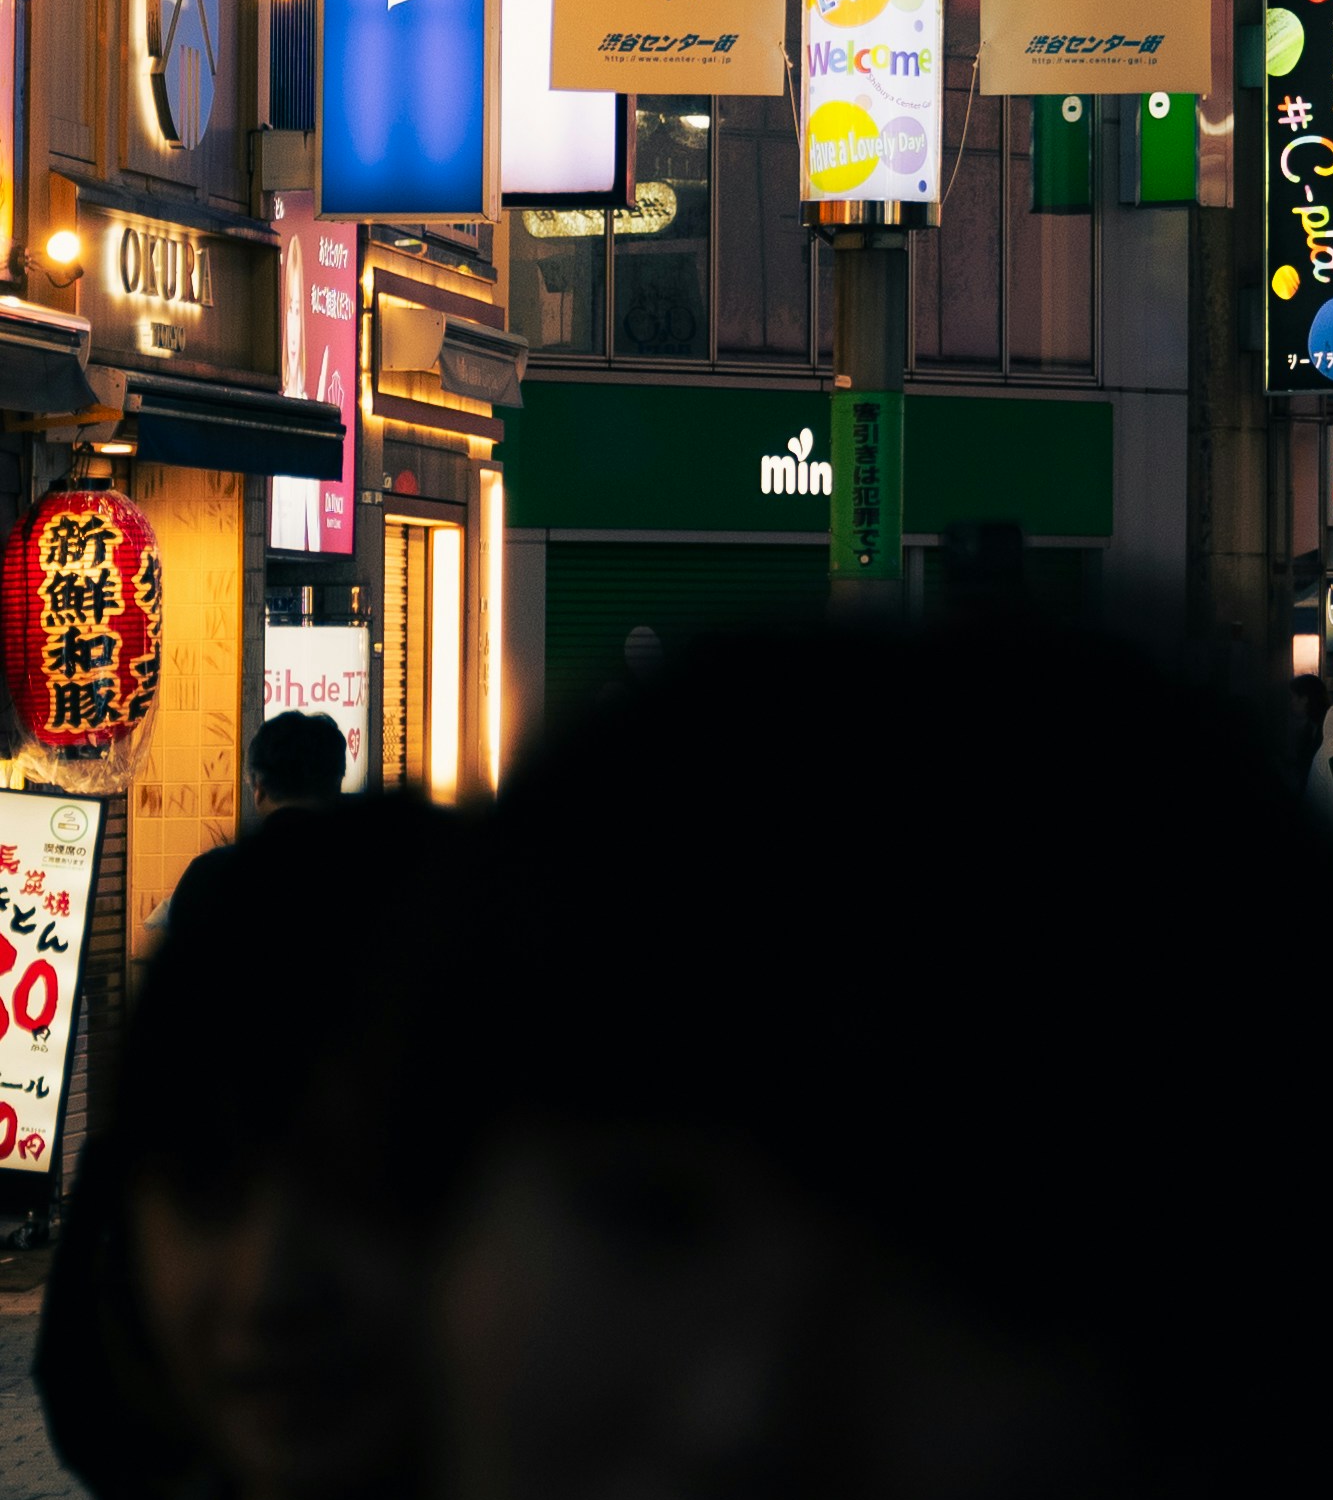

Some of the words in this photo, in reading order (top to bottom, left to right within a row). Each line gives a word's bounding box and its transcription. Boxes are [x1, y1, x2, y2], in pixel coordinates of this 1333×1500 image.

[597, 33, 739, 54] 渋谷センター街
[807, 40, 931, 78] Welcome
[1025, 34, 1165, 55] 渋谷センター街
[849, 127, 896, 163] Lovely
[898, 128, 927, 152] Day!
[119, 227, 214, 308] OKURA
[46, 514, 121, 728] 新鮮和豚
[311, 674, 340, 702] de
